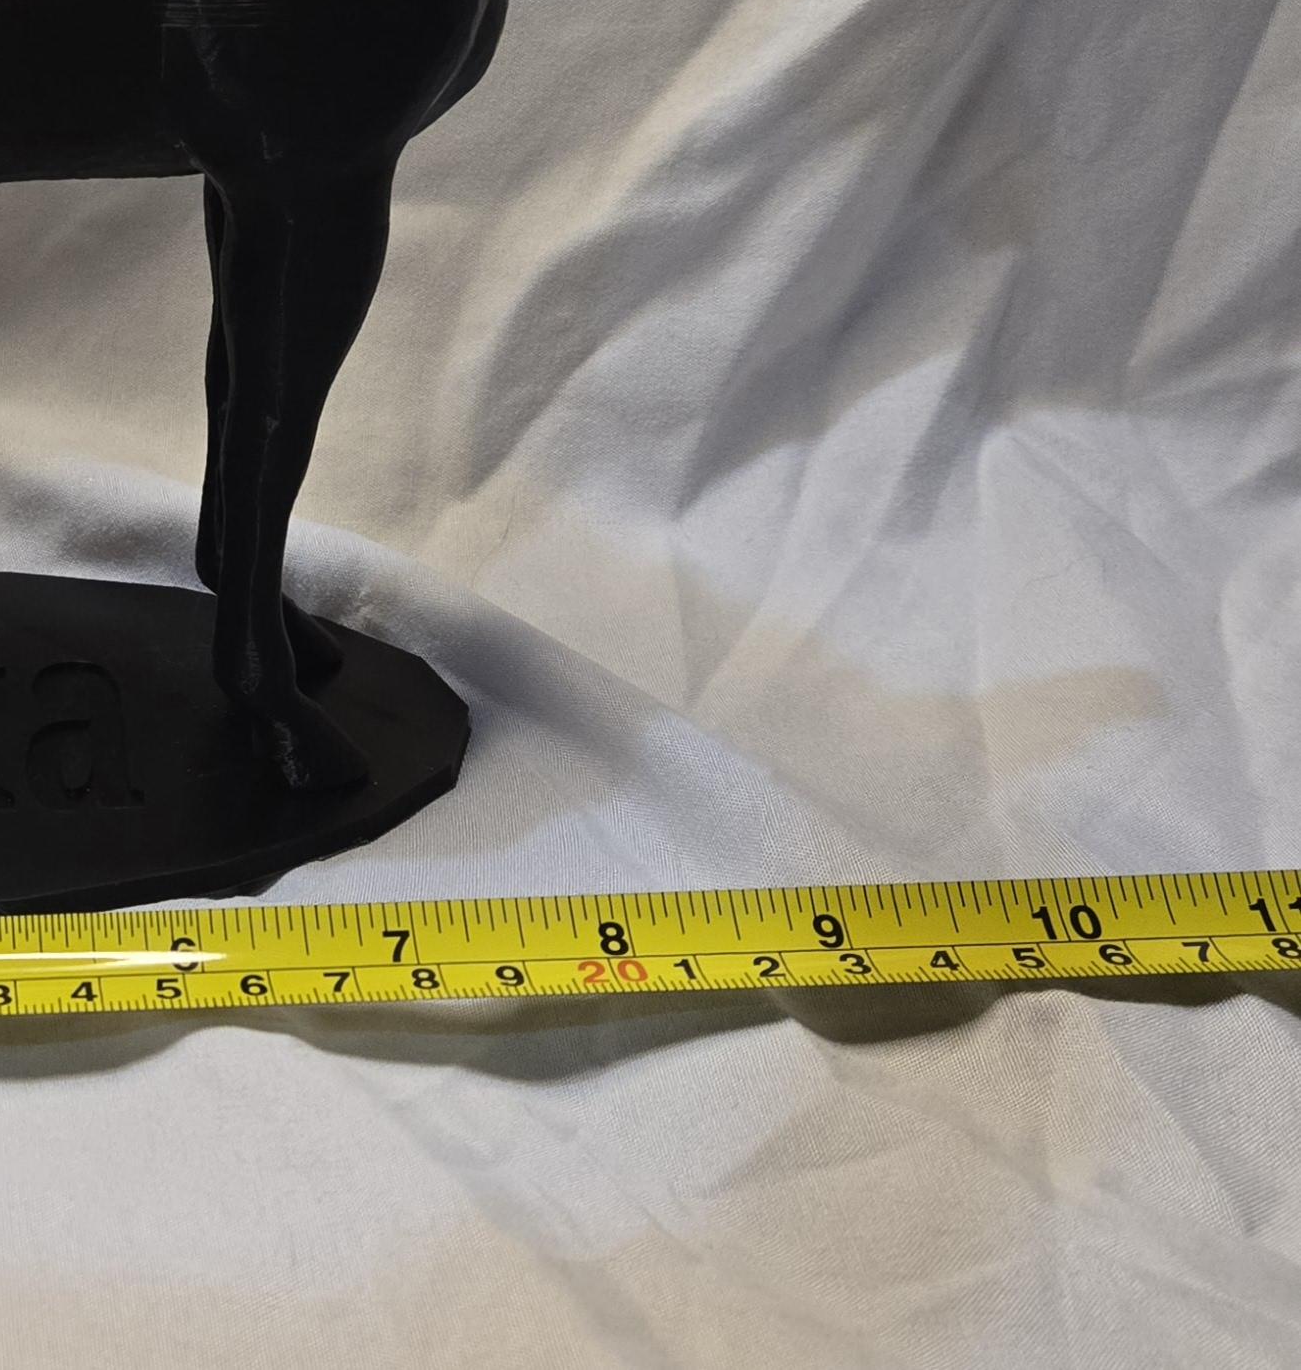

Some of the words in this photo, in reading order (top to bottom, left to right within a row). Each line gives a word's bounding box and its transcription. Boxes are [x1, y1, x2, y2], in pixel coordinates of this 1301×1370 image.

[382, 931, 411, 963] 7
[600, 921, 629, 955] 8
[813, 915, 844, 948] 9
[1032, 904, 1101, 941] 10
[71, 982, 98, 1003] 4
[155, 978, 183, 1000] 5
[240, 974, 267, 997] 6
[324, 972, 351, 993] 7
[413, 968, 440, 989] 8
[497, 966, 524, 987] 9
[674, 960, 697, 980] 1
[753, 956, 787, 979] 2
[839, 952, 872, 975] 3
[930, 950, 960, 972] 4
[1012, 947, 1045, 969] 5
[1098, 945, 1131, 966] 6
[1181, 942, 1210, 962] 7
